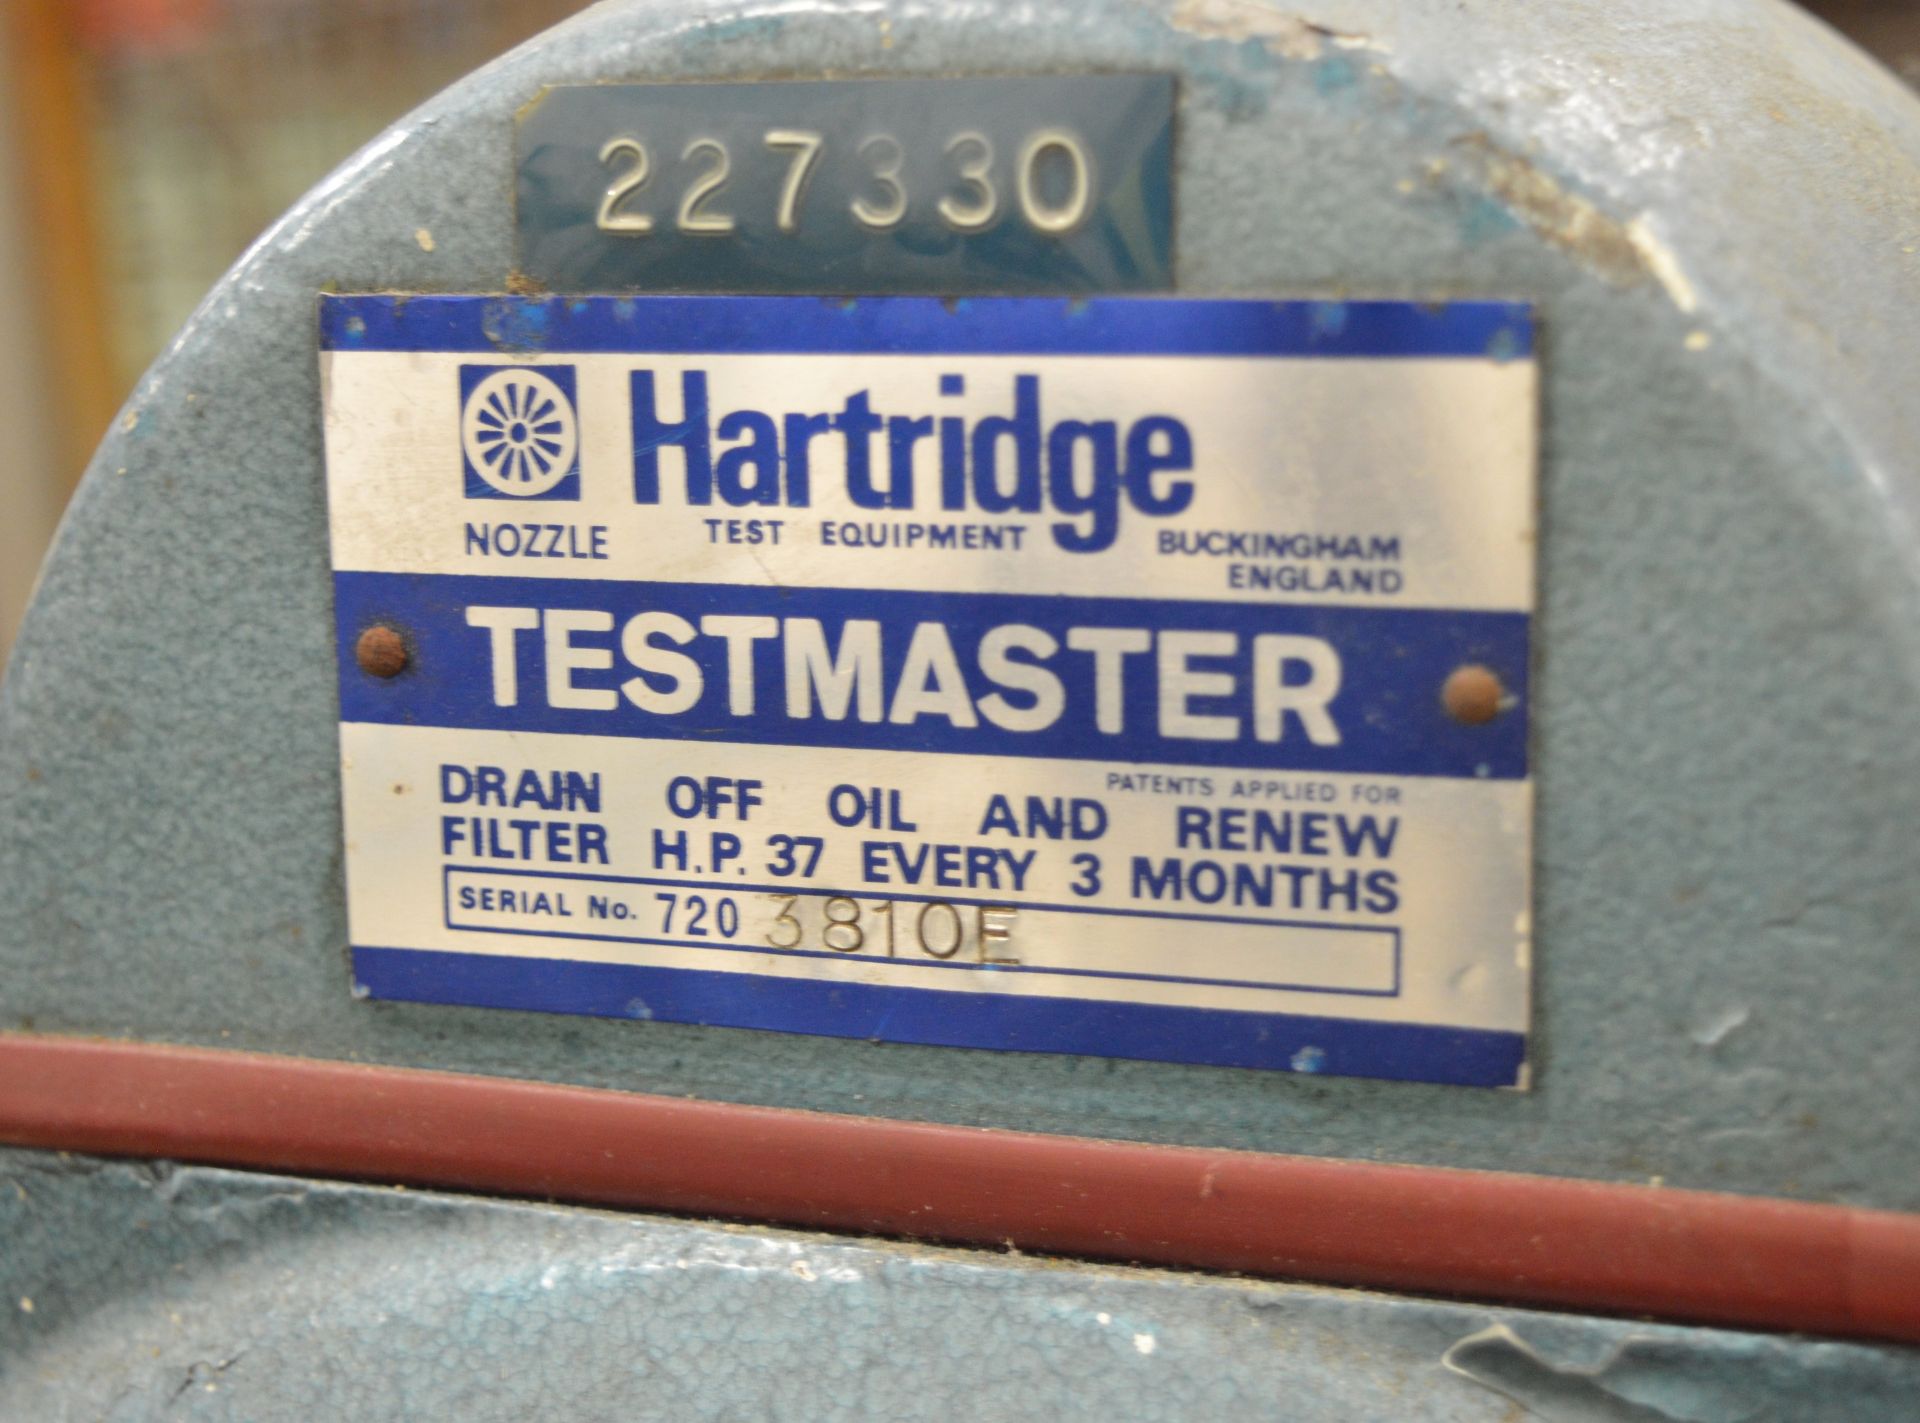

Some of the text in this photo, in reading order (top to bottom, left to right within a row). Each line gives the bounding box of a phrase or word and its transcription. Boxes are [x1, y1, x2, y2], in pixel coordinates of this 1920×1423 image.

[597, 127, 1091, 232] 227330
[630, 369, 1195, 554] Hartridge
[465, 522, 609, 560] NOZZLE
[704, 518, 1027, 551] TEST EQUIPMENT
[1158, 529, 1401, 562] BUCKINGHAM
[1227, 563, 1402, 594] ENGLAND
[465, 605, 1343, 747] TESTMASTER
[440, 764, 1400, 859] DRAIN OFF OIL AND RENEW
[1106, 772, 1402, 805] PATENTS APPLIED FOR
[443, 816, 1400, 914] FILTER H.P. 37 EVERY 3 MONTHS
[459, 886, 1021, 965] SERIAL No. 720 3810E
